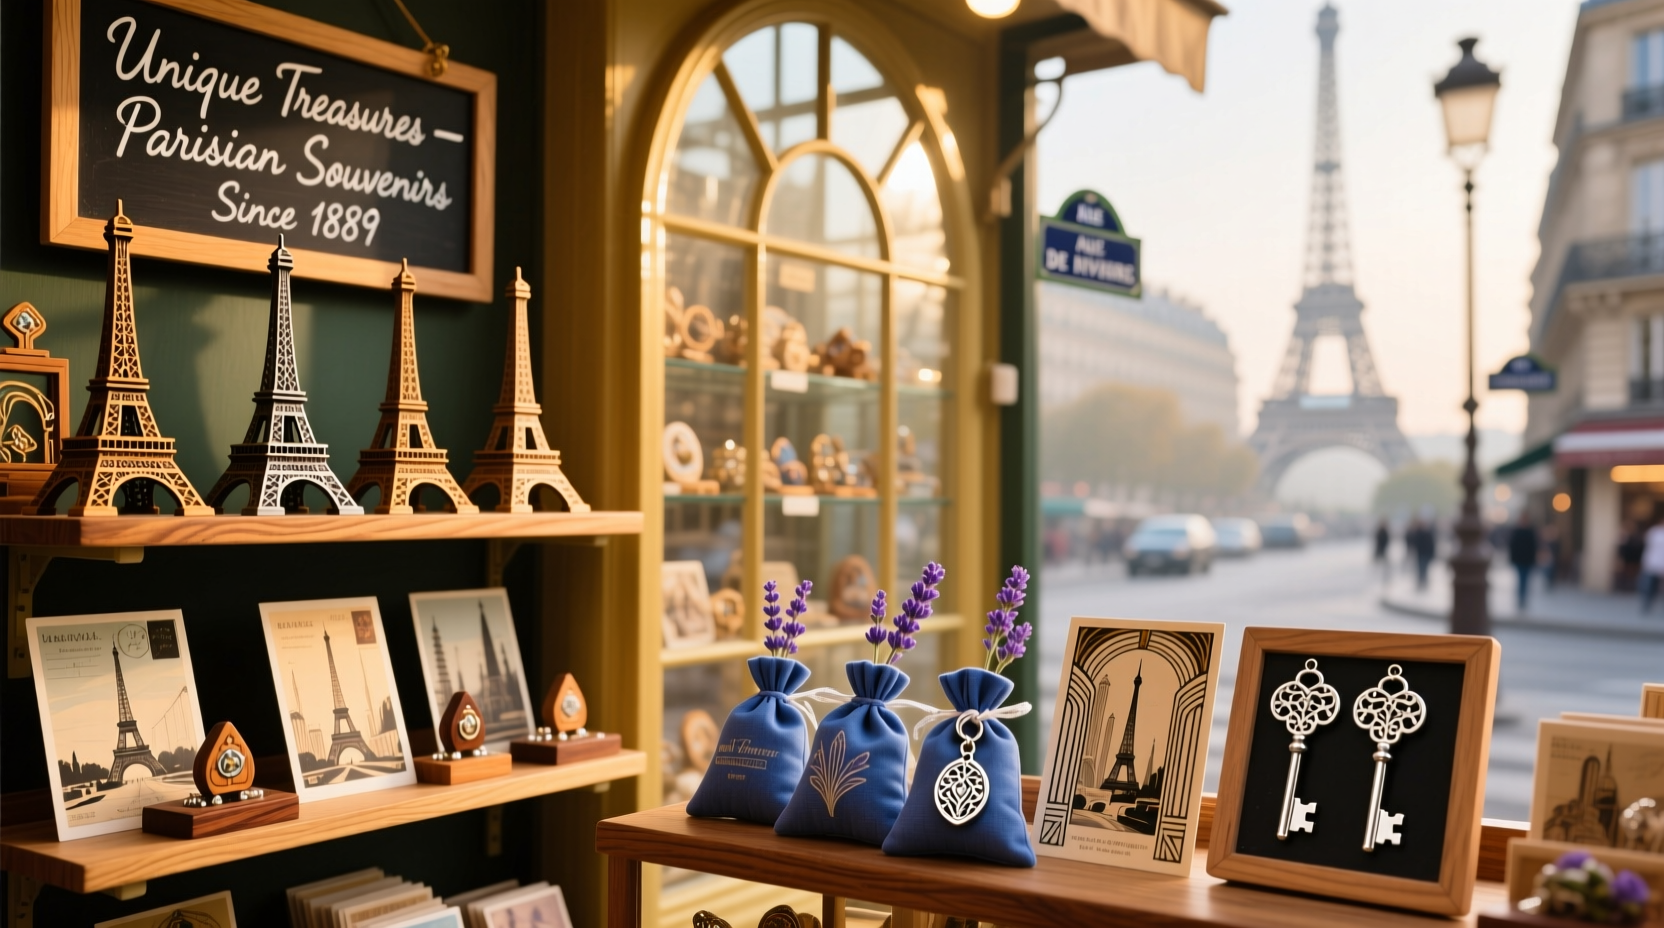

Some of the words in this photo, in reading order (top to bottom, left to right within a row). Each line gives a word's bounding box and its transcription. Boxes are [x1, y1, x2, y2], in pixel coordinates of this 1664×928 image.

[106, 16, 263, 119] Unique
[275, 62, 426, 146] Treasures
[116, 96, 287, 176] Parisian
[296, 134, 452, 211] Souvenirs
[211, 180, 298, 231] Since
[310, 201, 381, 247] 1889
[1045, 247, 1069, 272] DE
